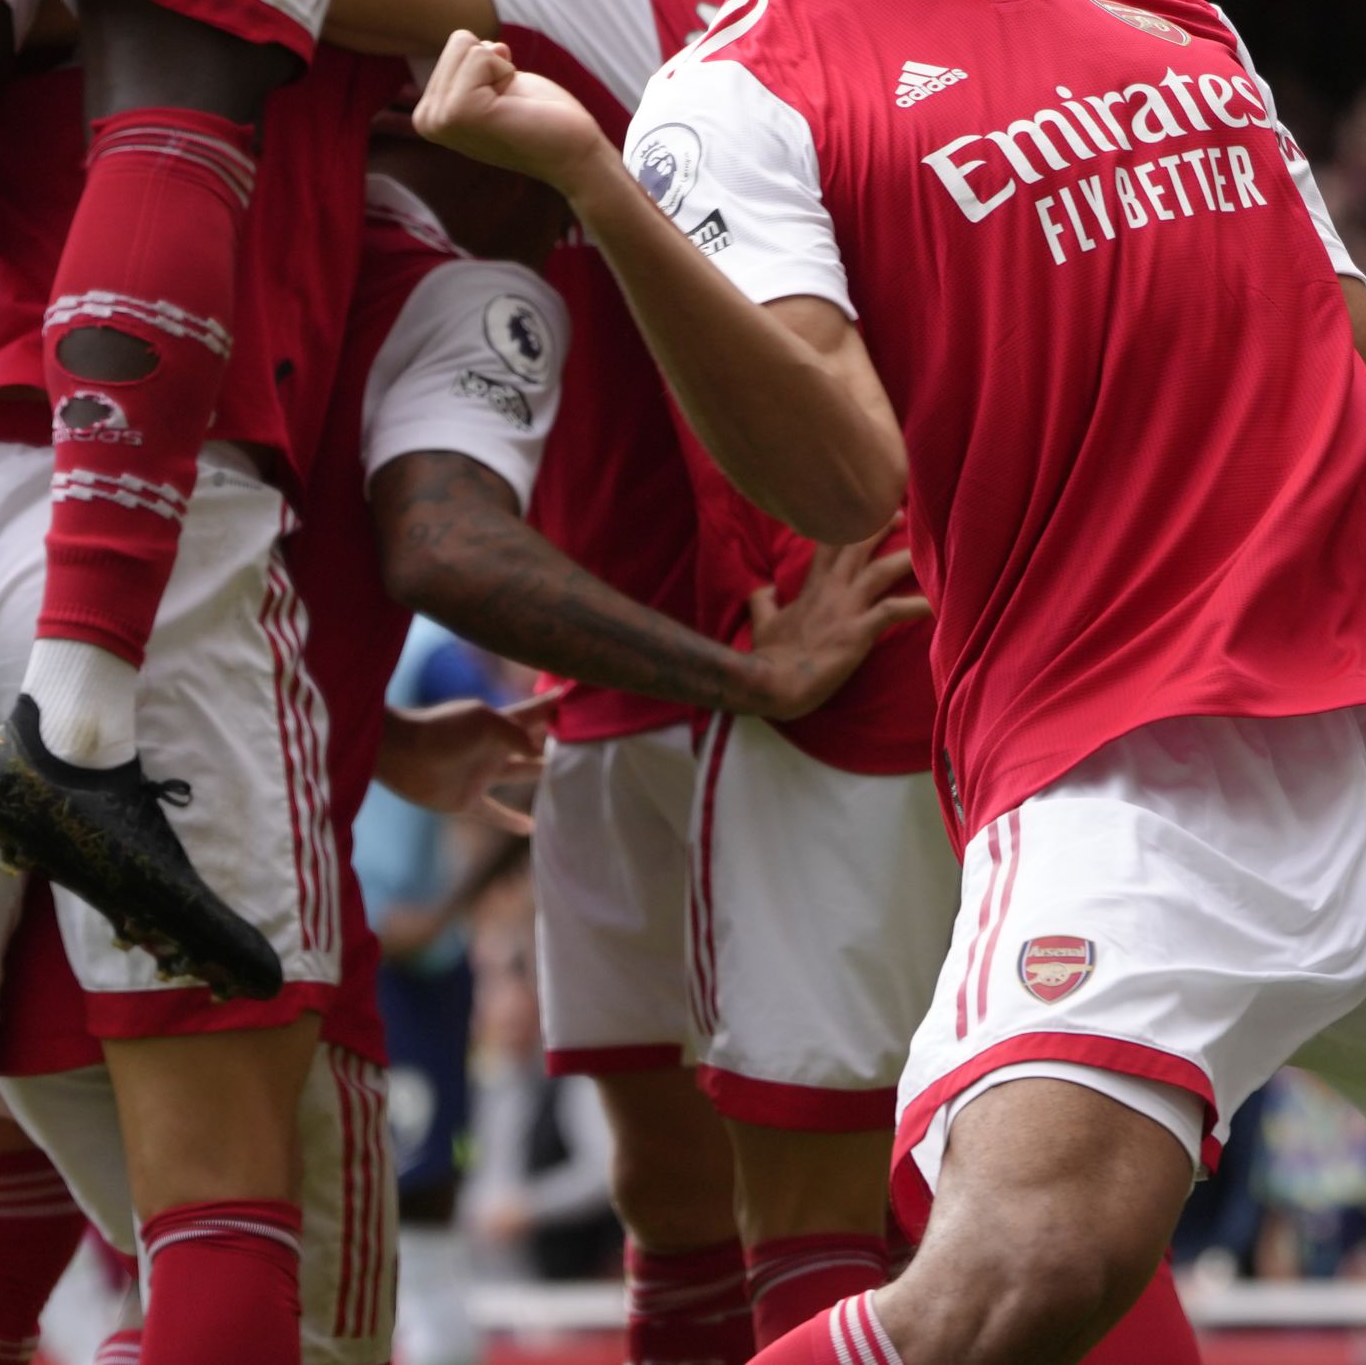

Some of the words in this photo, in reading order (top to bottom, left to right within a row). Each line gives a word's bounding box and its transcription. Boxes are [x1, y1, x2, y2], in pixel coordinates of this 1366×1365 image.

[895, 68, 969, 108] adidas
[921, 66, 1273, 224] Emirates
[1035, 175, 1116, 267] FLY
[1115, 145, 1267, 230] BETTER
